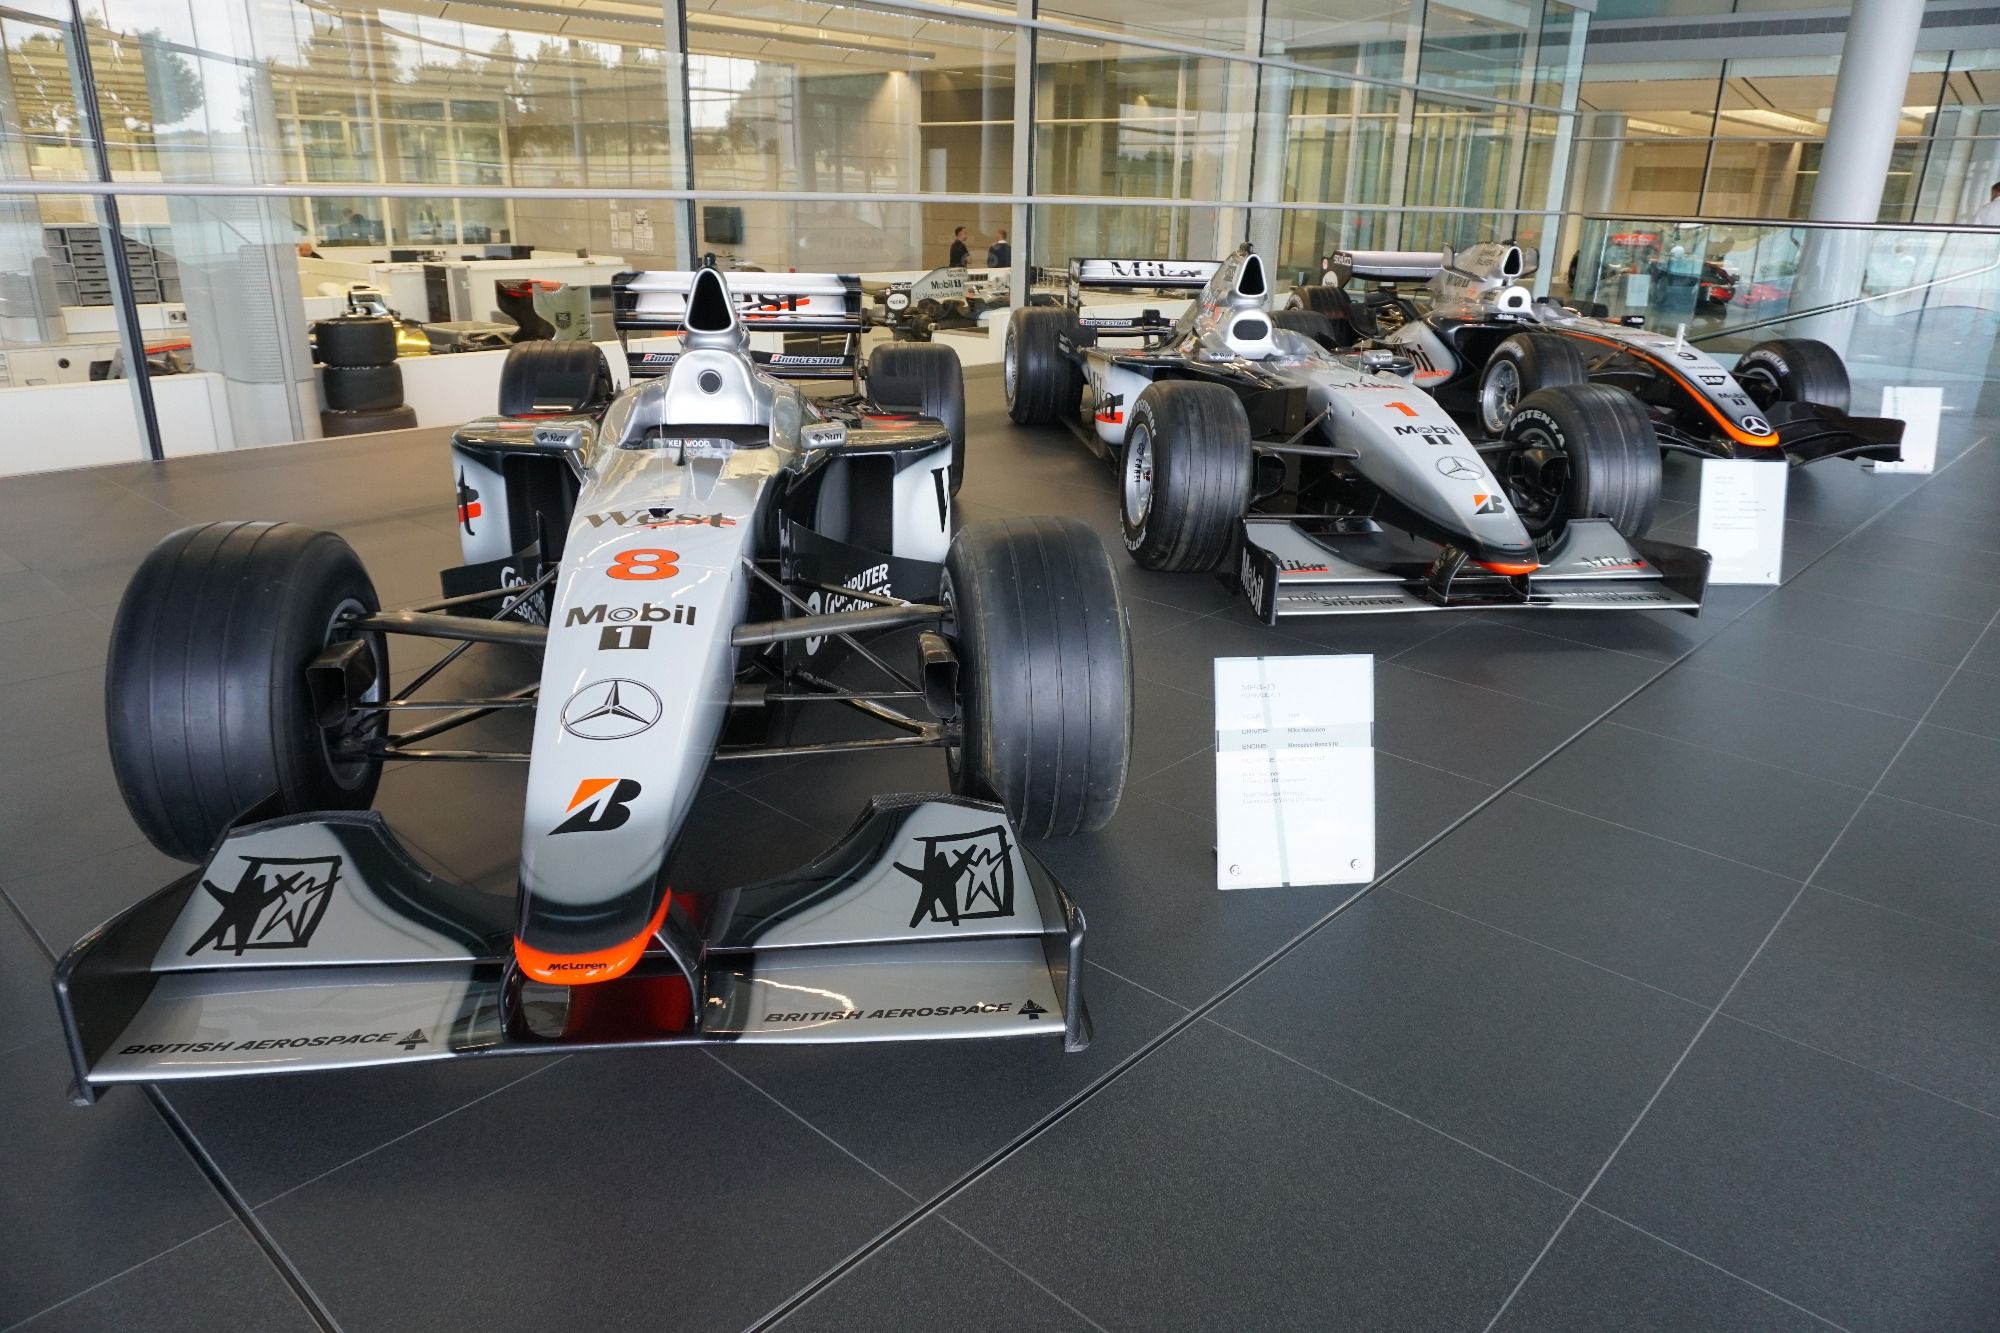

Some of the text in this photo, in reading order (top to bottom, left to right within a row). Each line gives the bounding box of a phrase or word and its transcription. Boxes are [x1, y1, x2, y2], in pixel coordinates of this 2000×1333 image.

[769, 353, 844, 365] BRIDGESTONE
[1383, 401, 1420, 417] 1
[824, 432, 842, 441] Sun
[1393, 425, 1460, 436] Mobil
[1510, 409, 1565, 448] POTENZA
[548, 432, 567, 442] Sun
[606, 548, 680, 581] 8
[1241, 547, 1264, 616] Mobil
[1320, 598, 1404, 608] SIEMENS
[565, 603, 696, 628] Mobil
[547, 963, 608, 971] McLaren
[764, 1002, 1013, 1023] BRITISH AEROSPACE
[118, 1032, 399, 1056] BRITISH AEROSPACE
